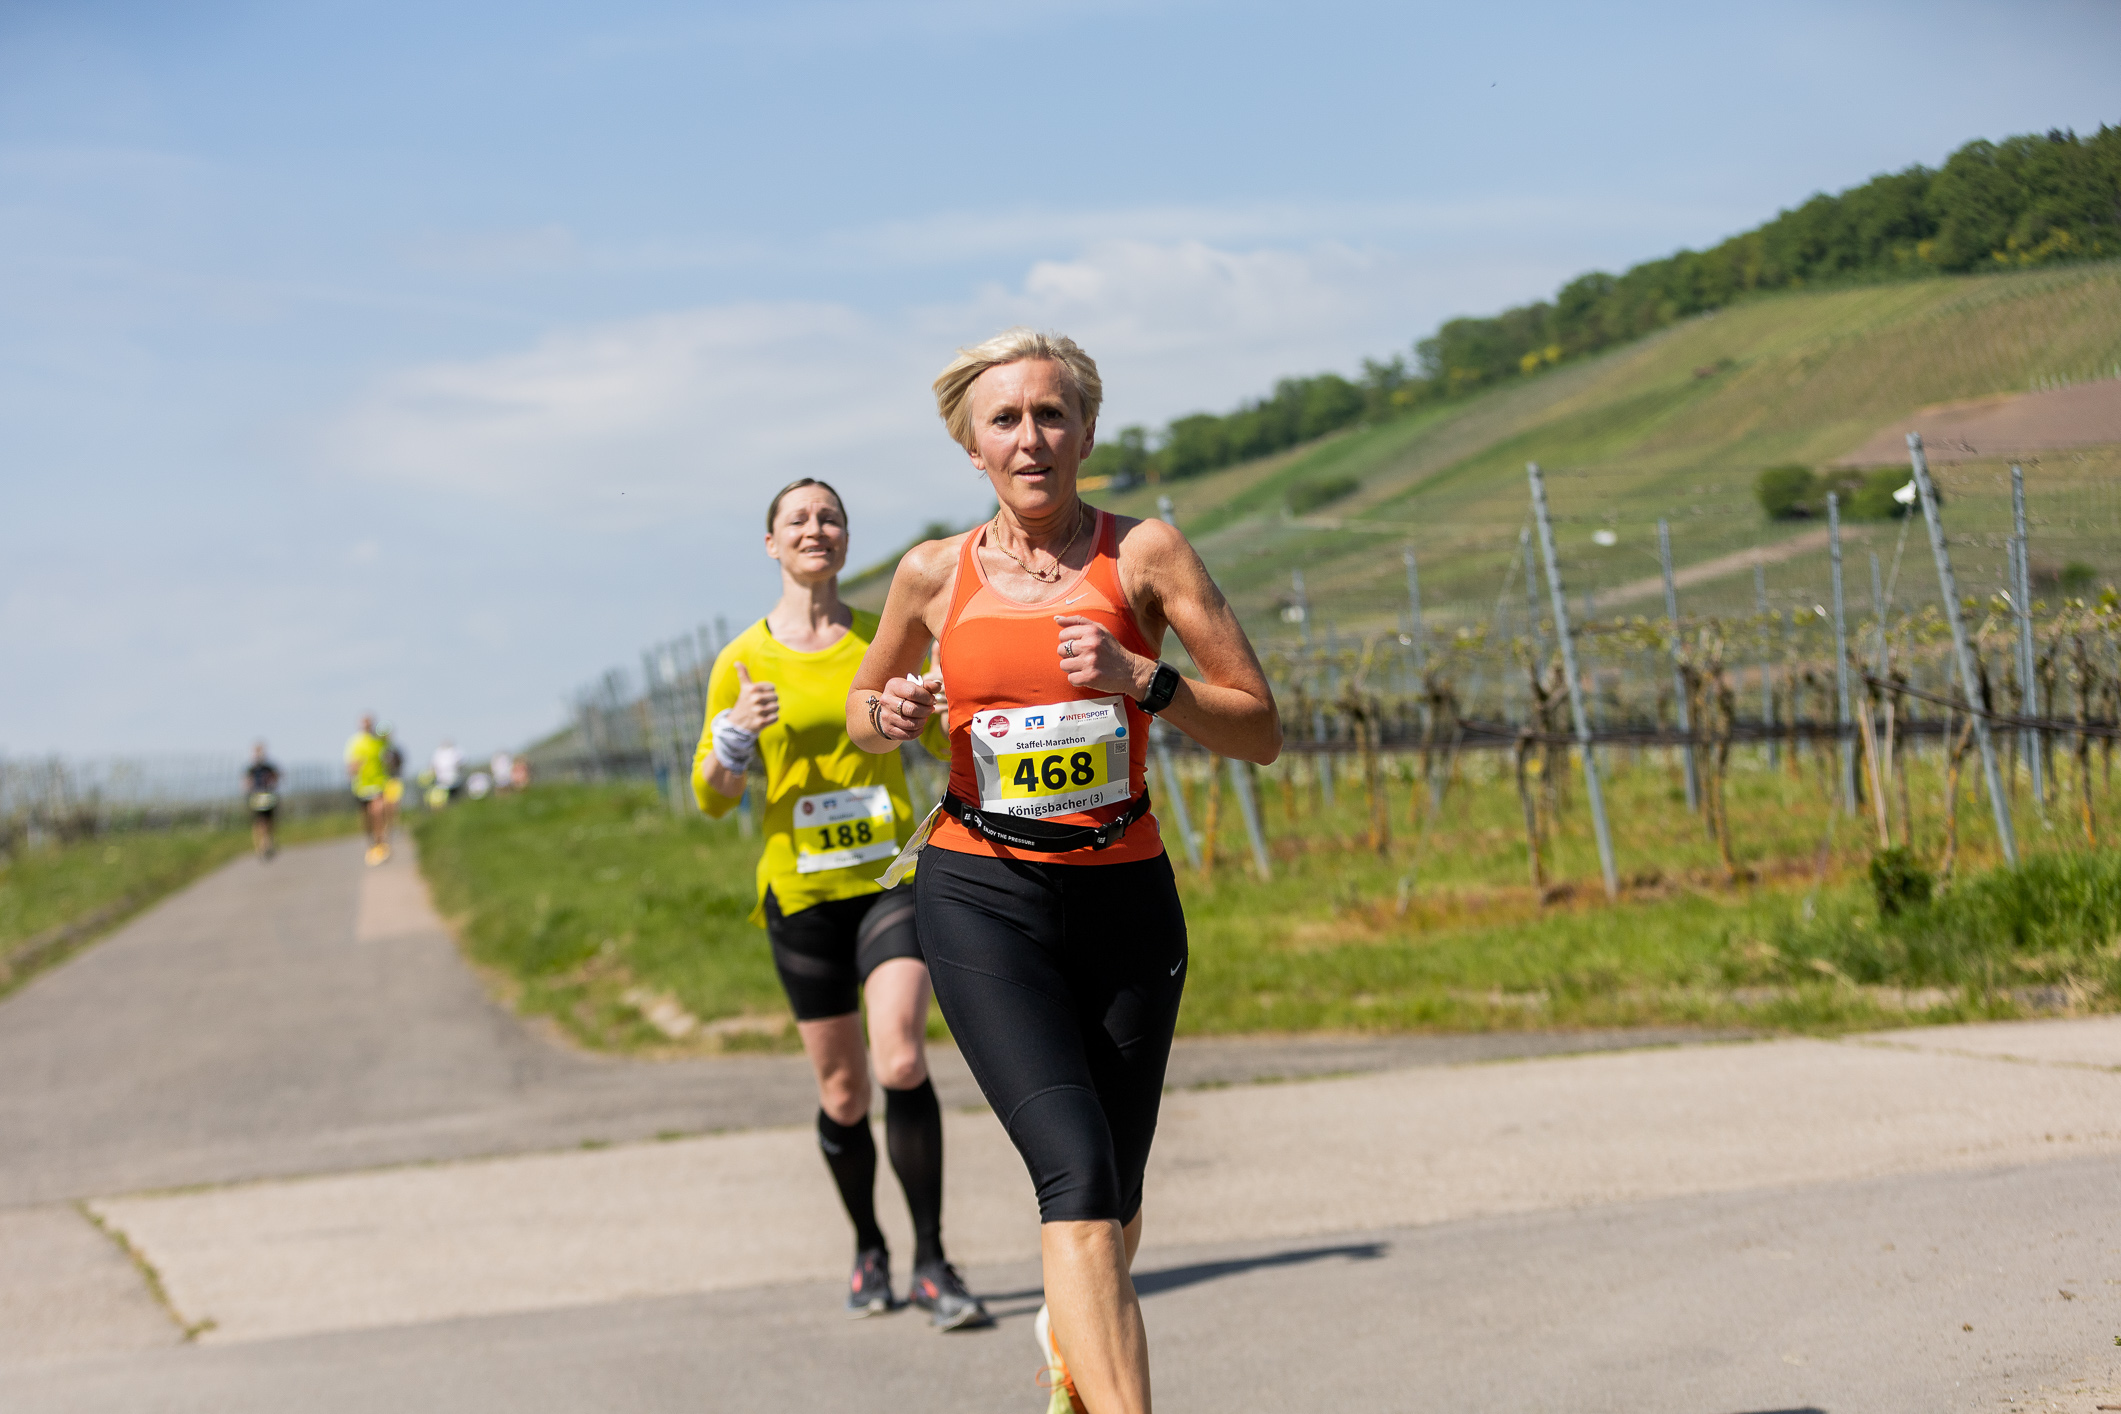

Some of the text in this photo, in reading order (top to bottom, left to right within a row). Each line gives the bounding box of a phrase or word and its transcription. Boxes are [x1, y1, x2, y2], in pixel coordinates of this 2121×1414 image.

[1065, 710, 1109, 721] INTERSPORT
[1016, 736, 1086, 750] Staffel-Marathon
[1013, 751, 1095, 793] 468
[1008, 791, 1104, 817] Königsbacher (3)
[818, 821, 873, 851] 188
[983, 826, 996, 836] ENJOY
[997, 832, 1007, 840] THE
[1008, 835, 1035, 846] PRESSURE
